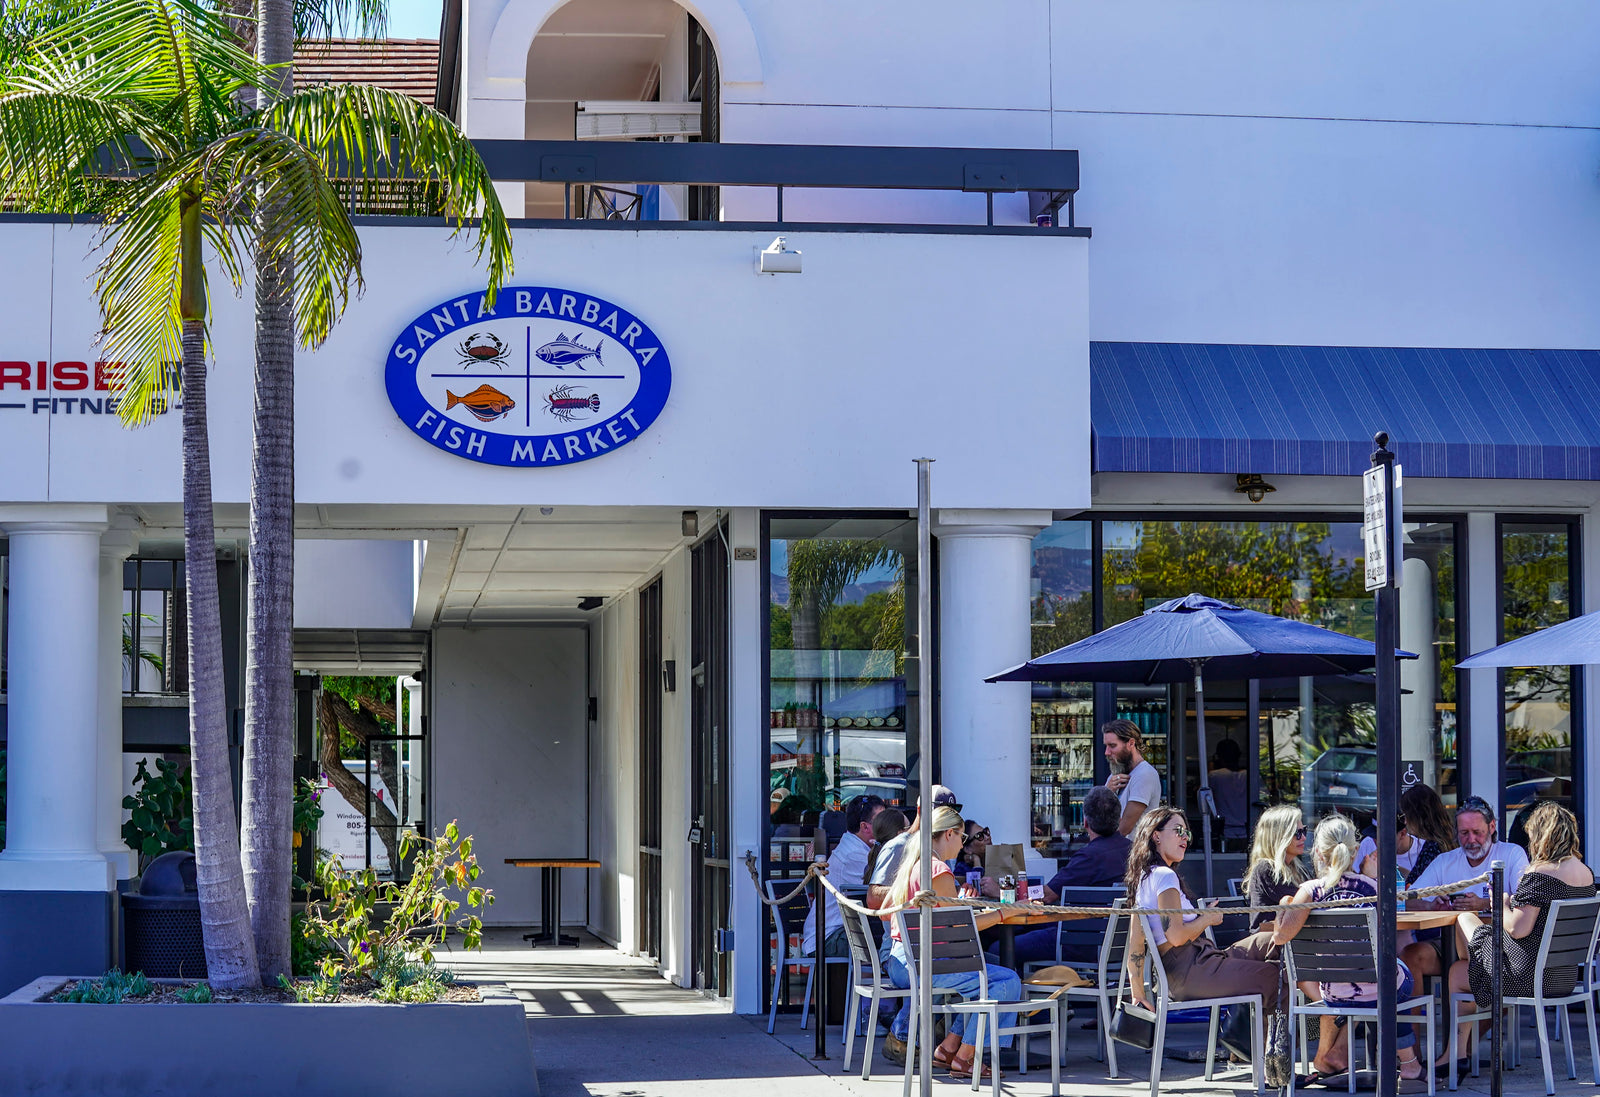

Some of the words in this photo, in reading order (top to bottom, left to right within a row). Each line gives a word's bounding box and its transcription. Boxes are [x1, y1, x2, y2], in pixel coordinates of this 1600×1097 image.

[395, 295, 497, 365] SANTA
[515, 290, 660, 367] BARBARA
[0, 361, 127, 390] RISE
[32, 397, 168, 415] FITNES
[415, 409, 488, 457] FISH
[510, 408, 642, 463] MARKET
